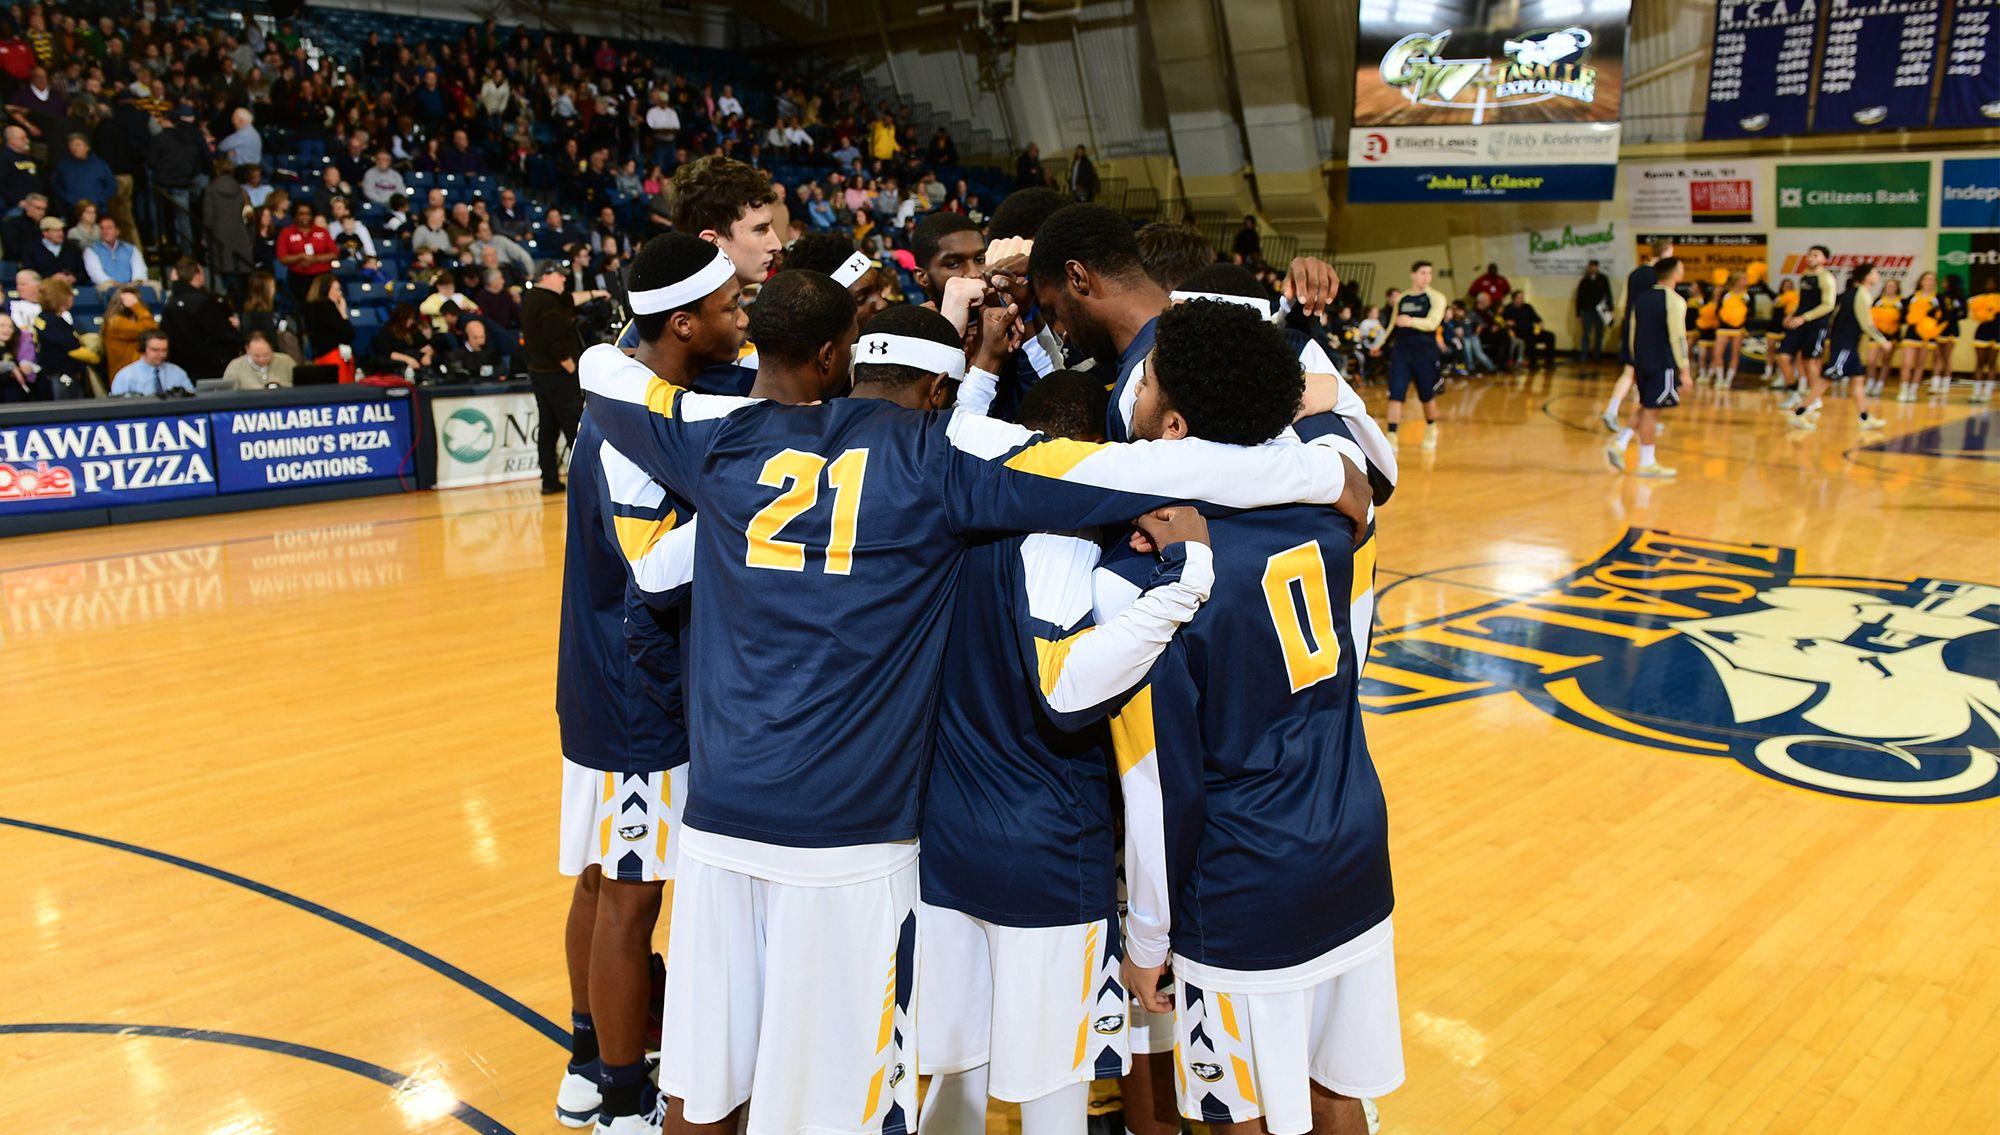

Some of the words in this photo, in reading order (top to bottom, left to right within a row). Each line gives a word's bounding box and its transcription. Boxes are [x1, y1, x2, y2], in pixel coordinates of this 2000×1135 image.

[1829, 1, 1938, 19] APPEARANCES
[1717, 13, 1816, 32] APPEARANCES
[1496, 62, 1597, 86] LASALLE
[1496, 79, 1597, 103] EXPLORERS
[1395, 136, 1478, 149] Elliott-Lewis
[1542, 129, 1613, 145] Redeemer
[1427, 173, 1468, 190] John
[1490, 173, 1544, 188] Glaser
[1807, 190, 1874, 205] Citizens
[1875, 189, 1920, 204] Bank
[232, 407, 334, 434] AVAILABLE
[336, 405, 360, 425] AT
[362, 403, 396, 423] ALL
[240, 433, 337, 461] DOMINO'S
[338, 429, 391, 452] PIZZA
[81, 453, 215, 494] PIZZA
[266, 456, 374, 484] LOCATIONS.
[745, 447, 869, 575] 21
[1260, 540, 1341, 694] 0
